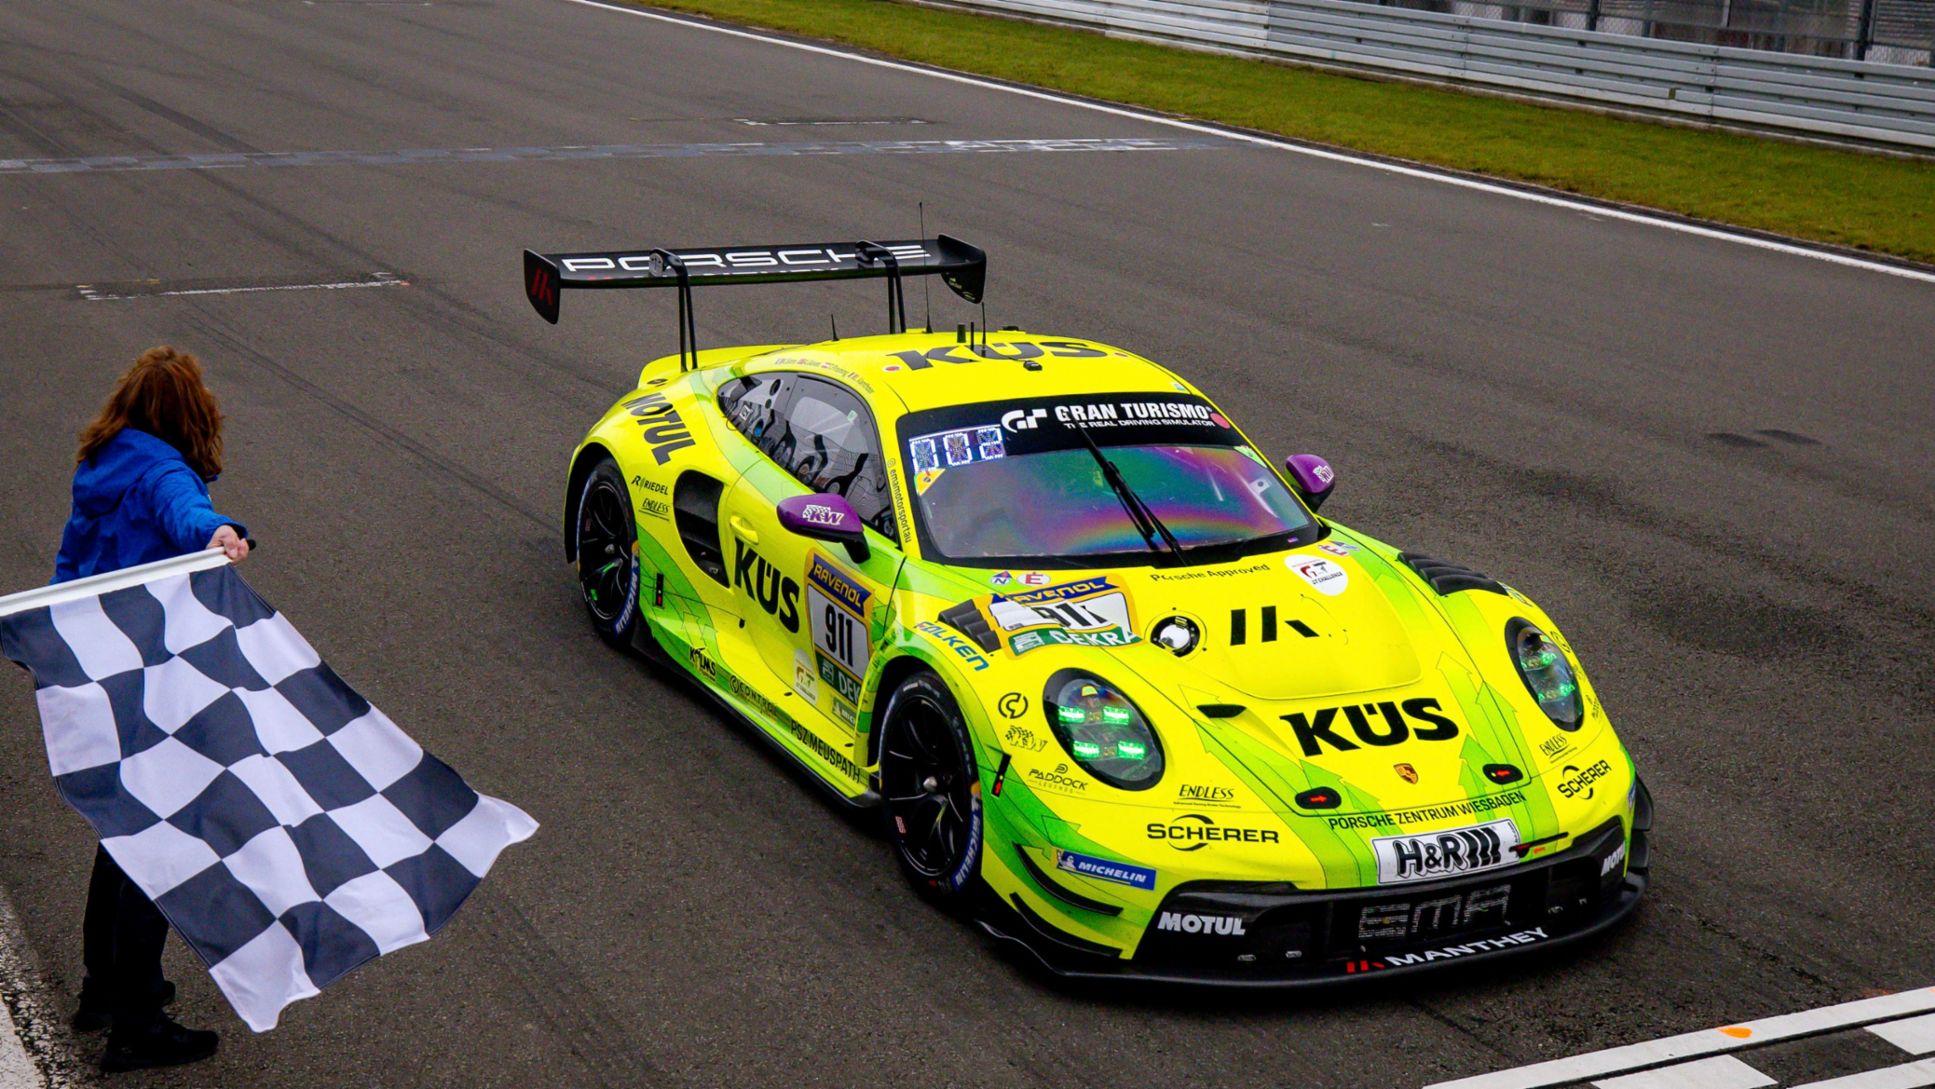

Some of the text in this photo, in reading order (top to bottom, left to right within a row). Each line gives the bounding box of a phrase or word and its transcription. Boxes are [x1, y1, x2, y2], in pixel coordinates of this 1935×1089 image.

[562, 245, 930, 272] PORSCHE
[885, 341, 1108, 371] KÜS
[1055, 402, 1210, 422] GRAN TURISMO
[1089, 420, 1118, 428] REAL
[1120, 418, 1161, 427] DRIVING
[1162, 418, 1216, 427] SIMULATOR
[621, 392, 696, 466] MOTUL
[643, 481, 669, 496] RIEDEL
[734, 536, 800, 634] KÜS
[812, 563, 862, 608] RAVENOL
[1150, 564, 1271, 582] Porsche Approved
[1000, 582, 1105, 603] AVENOL
[825, 603, 854, 668] 911
[1048, 628, 1136, 647] DEKRA
[838, 670, 861, 706] DEK
[1279, 697, 1460, 757] KÜS
[790, 719, 862, 784] PSZ MEUSPATH
[1028, 768, 1088, 790] PADDOCK
[1178, 784, 1236, 799] ENDLESS
[1557, 759, 1612, 798] SCHERER
[1328, 790, 1526, 830] PORSCHE ZENTRUM WIESBADEN
[1147, 823, 1279, 844] SCHERER
[1078, 861, 1147, 883] MICHELIN
[1157, 911, 1245, 936] MOTUL
[1384, 926, 1549, 967] MANTHEY
